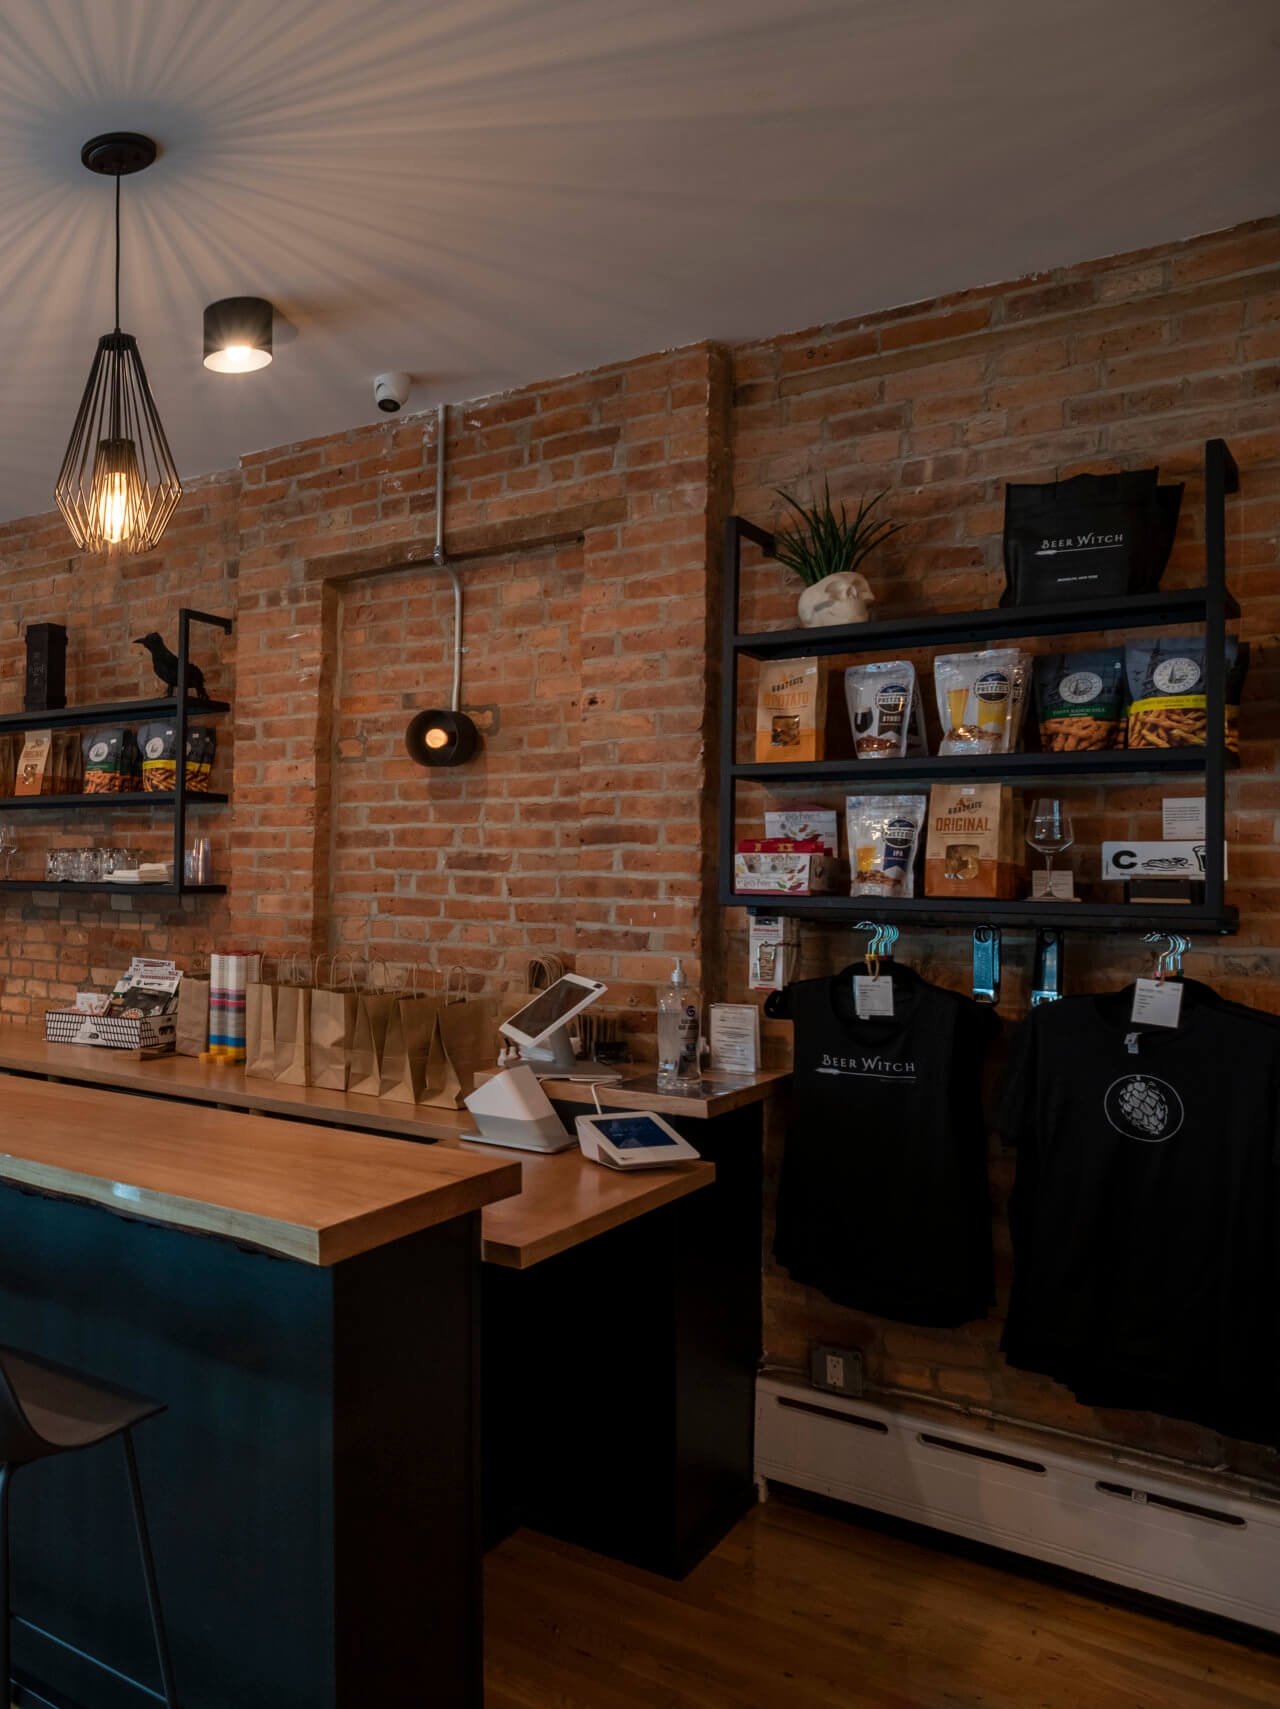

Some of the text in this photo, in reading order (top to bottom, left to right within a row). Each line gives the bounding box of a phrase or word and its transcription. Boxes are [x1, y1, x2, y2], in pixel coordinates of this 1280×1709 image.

[1040, 531, 1124, 550] BEER WITCH
[935, 817, 992, 832] ORIGINAL
[1112, 850, 1137, 870] C
[822, 1054, 916, 1073] BEER WITCH
